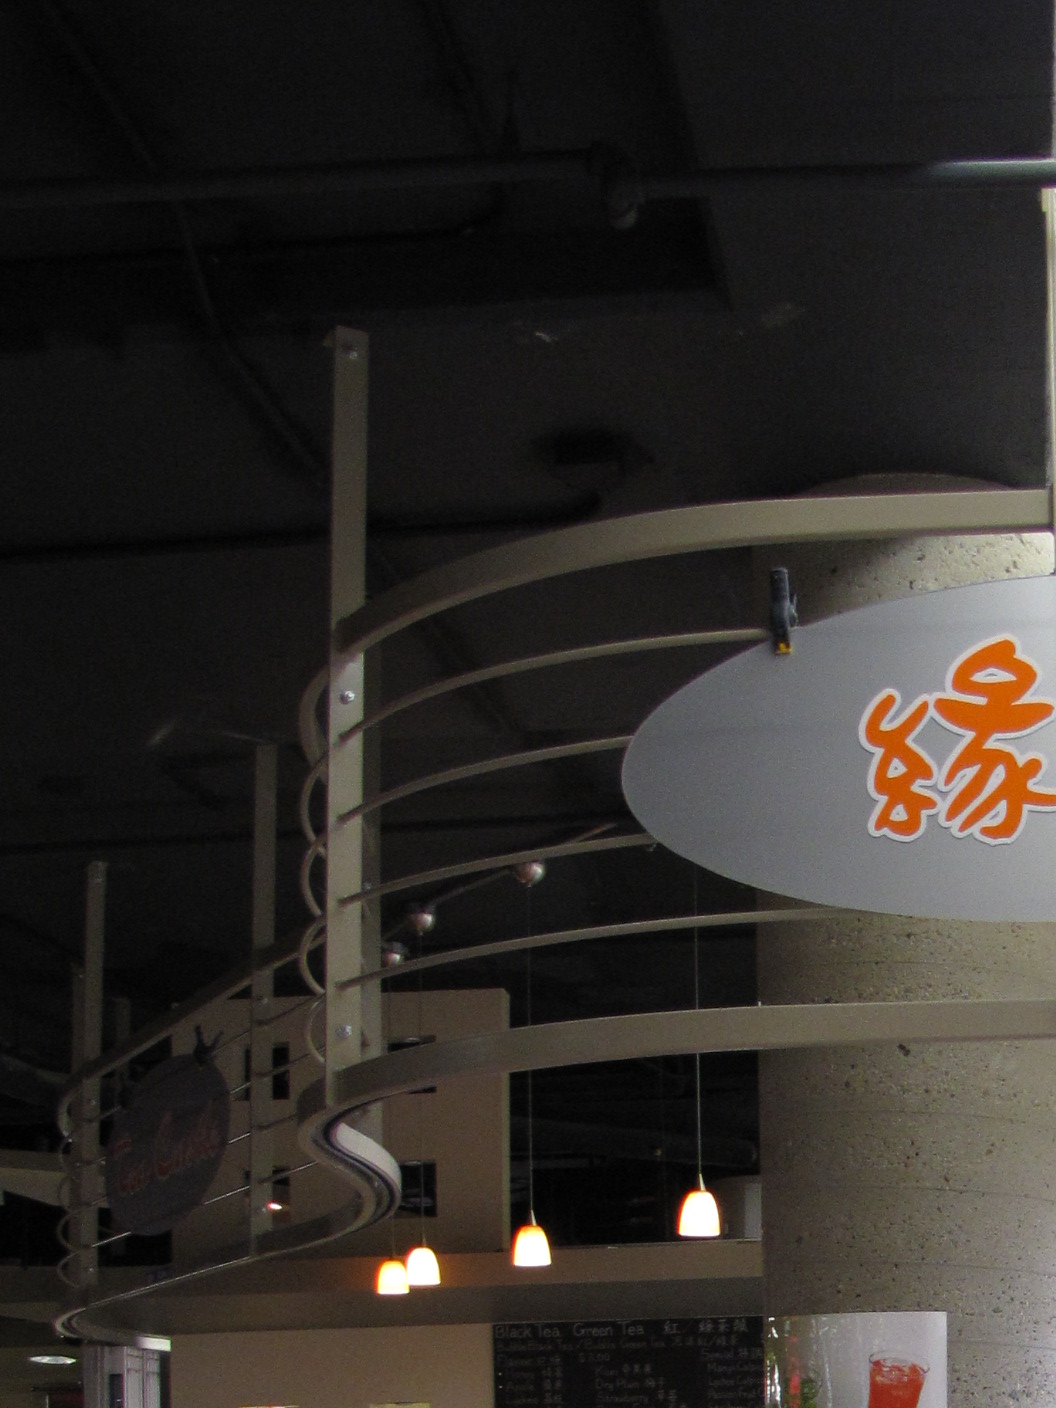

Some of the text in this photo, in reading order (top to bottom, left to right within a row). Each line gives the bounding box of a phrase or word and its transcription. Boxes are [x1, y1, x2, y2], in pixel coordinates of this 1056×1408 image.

[495, 1324, 533, 1339] Black
[535, 1323, 561, 1338] Tea
[573, 1322, 614, 1337] Green
[617, 1320, 645, 1336] Tea
